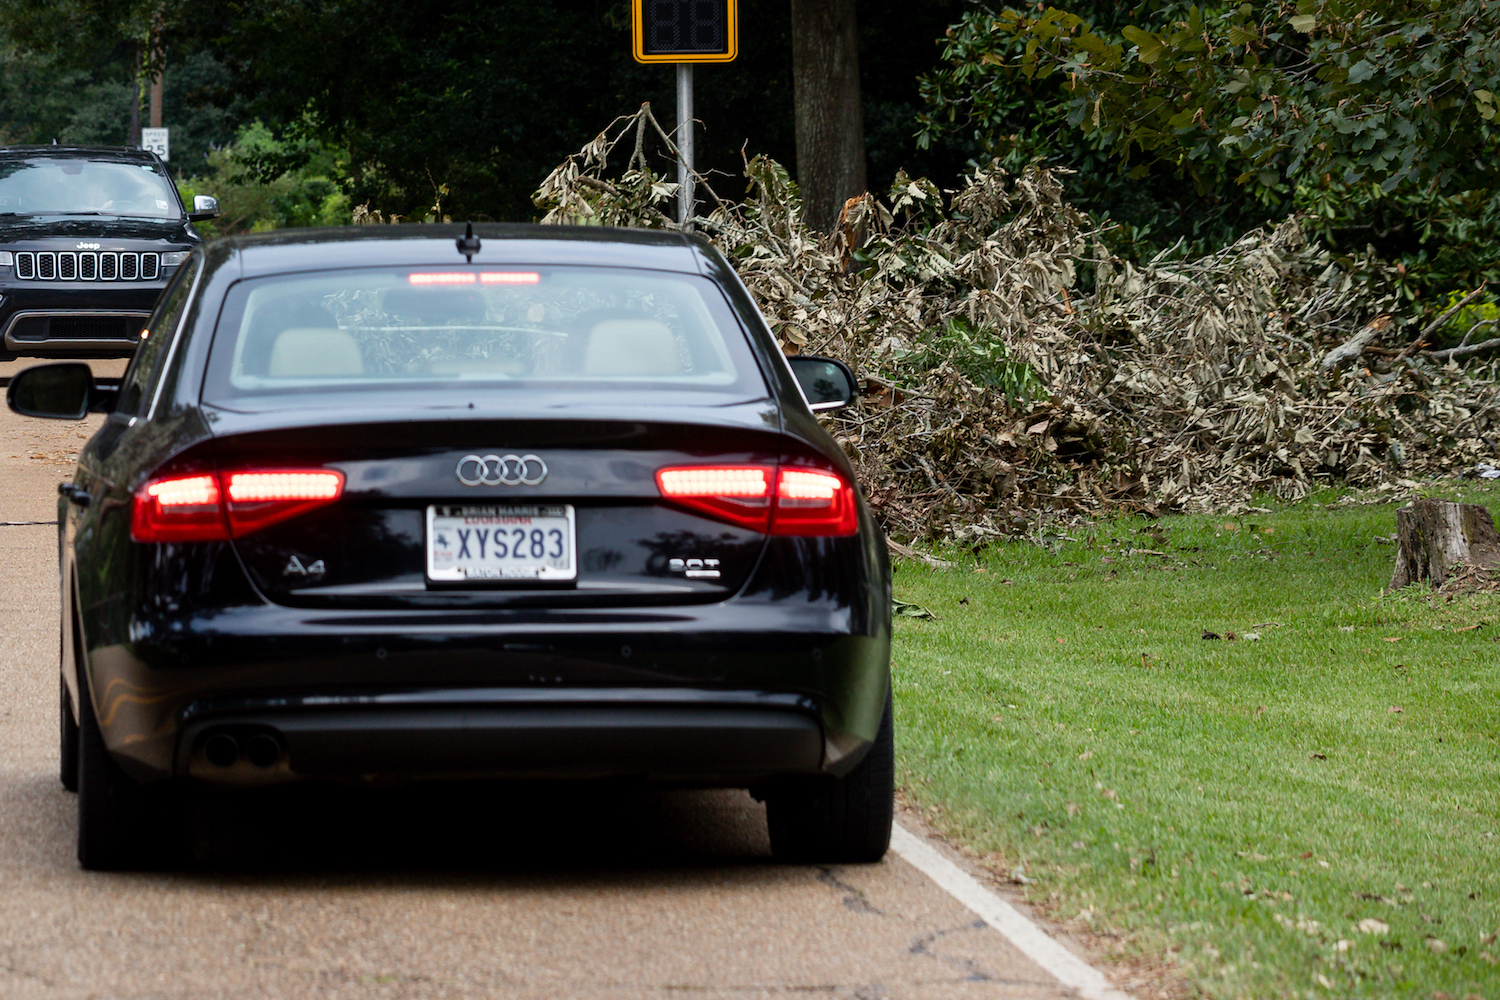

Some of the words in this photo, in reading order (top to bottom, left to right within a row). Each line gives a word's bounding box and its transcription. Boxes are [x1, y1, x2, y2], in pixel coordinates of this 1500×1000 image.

[76, 241, 100, 251] Jeep
[461, 506, 496, 517] BRIAN
[499, 506, 539, 517] HARRIS
[457, 528, 563, 559] XYS283
[283, 555, 326, 576] A4
